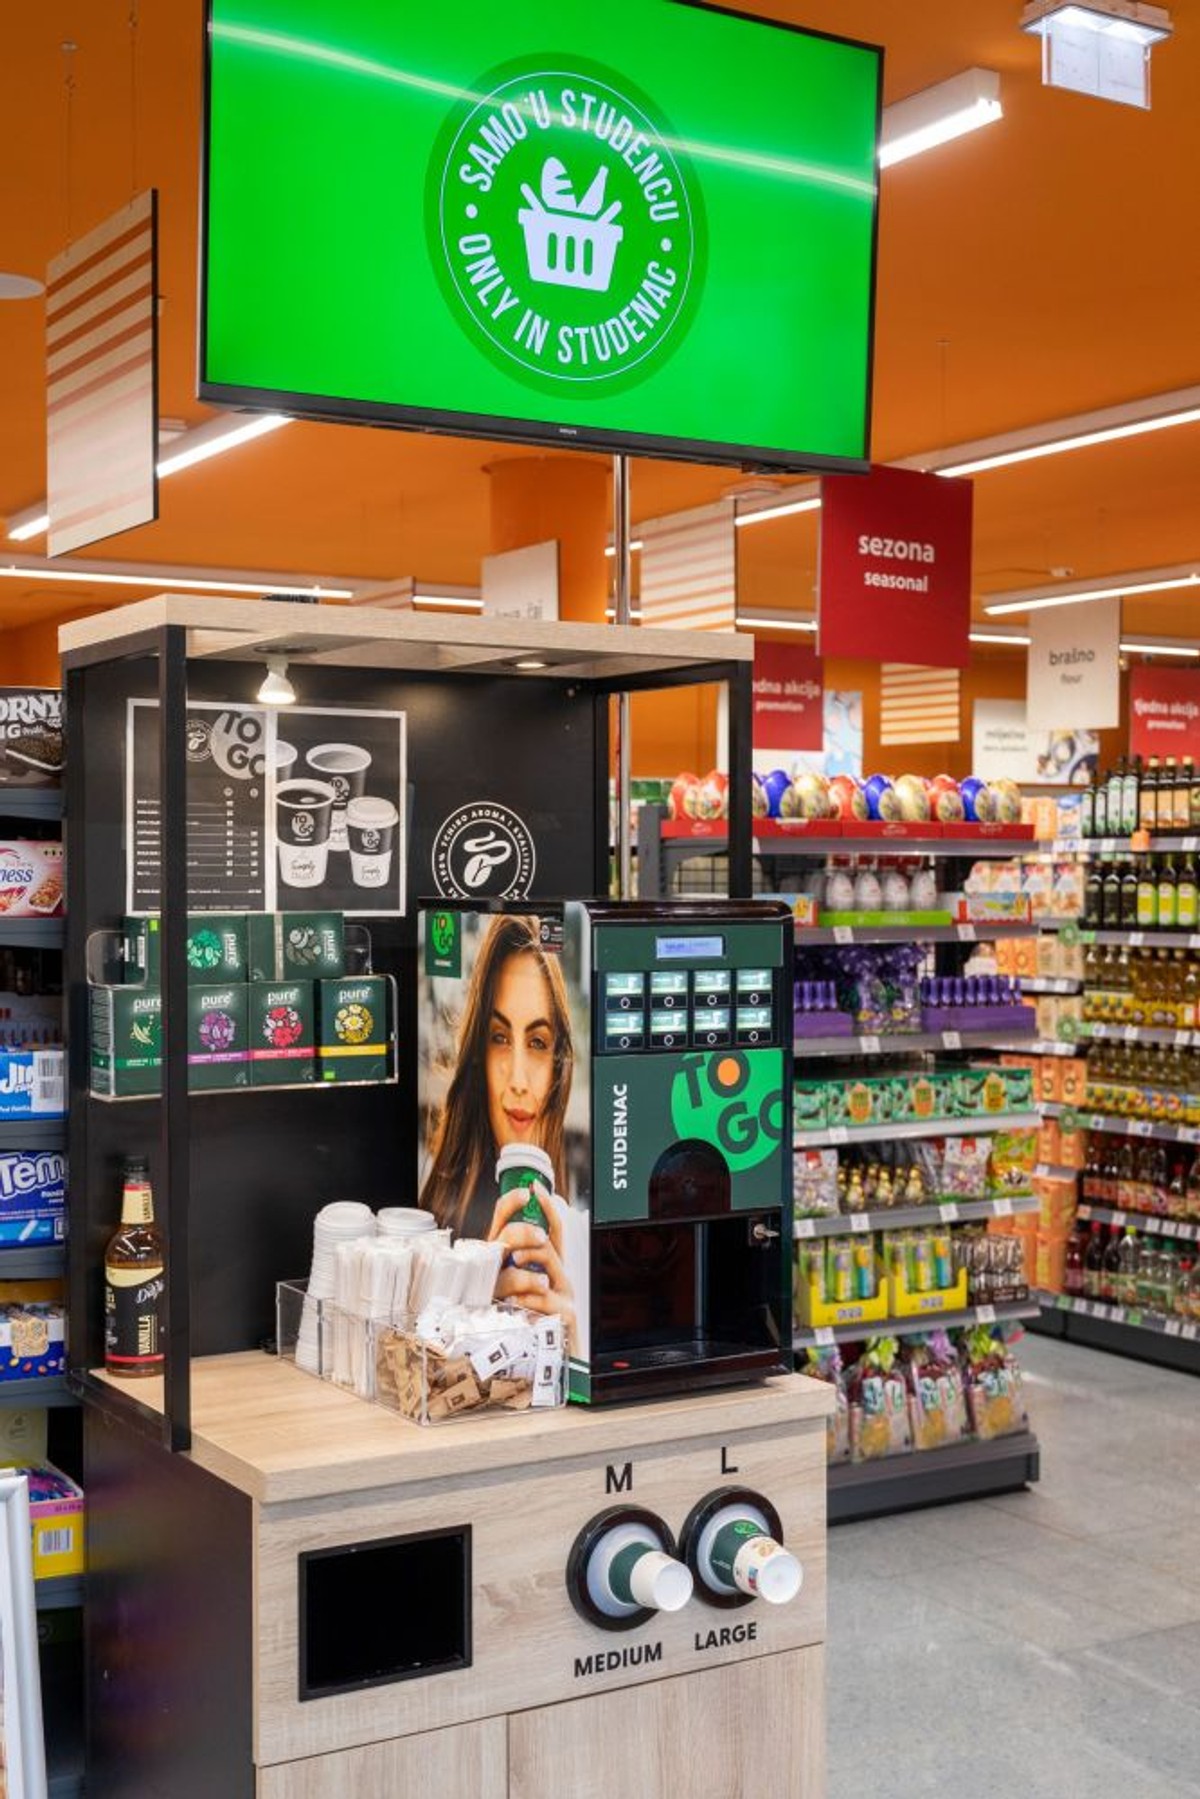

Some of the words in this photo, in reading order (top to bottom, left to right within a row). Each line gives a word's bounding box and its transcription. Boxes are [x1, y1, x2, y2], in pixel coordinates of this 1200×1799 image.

[459, 102, 528, 192] SAMO
[528, 89, 551, 129] U
[560, 88, 680, 222] STUDENCU
[458, 233, 520, 320] ONLY
[514, 308, 550, 356] IN
[557, 260, 677, 365] STUDENAC
[858, 535, 935, 563] sezona
[864, 572, 929, 593] seasonal
[1049, 647, 1095, 666] brašno
[219, 710, 262, 743] TO
[440, 814, 468, 847] TCHIBO
[471, 809, 505, 822] AROMA
[223, 933, 237, 965] pure
[322, 930, 337, 961] pure
[201, 994, 232, 1009] pure
[268, 990, 298, 1005] pure
[339, 988, 370, 1004] pure
[673, 1050, 750, 1109] TO
[613, 1083, 628, 1190] STUDENAC
[138, 1314, 151, 1356] VANILLA
[721, 1447, 738, 1475] L
[605, 1462, 633, 1494] M
[694, 1622, 758, 1651] LARGE
[574, 1642, 663, 1678] MEDIUM
